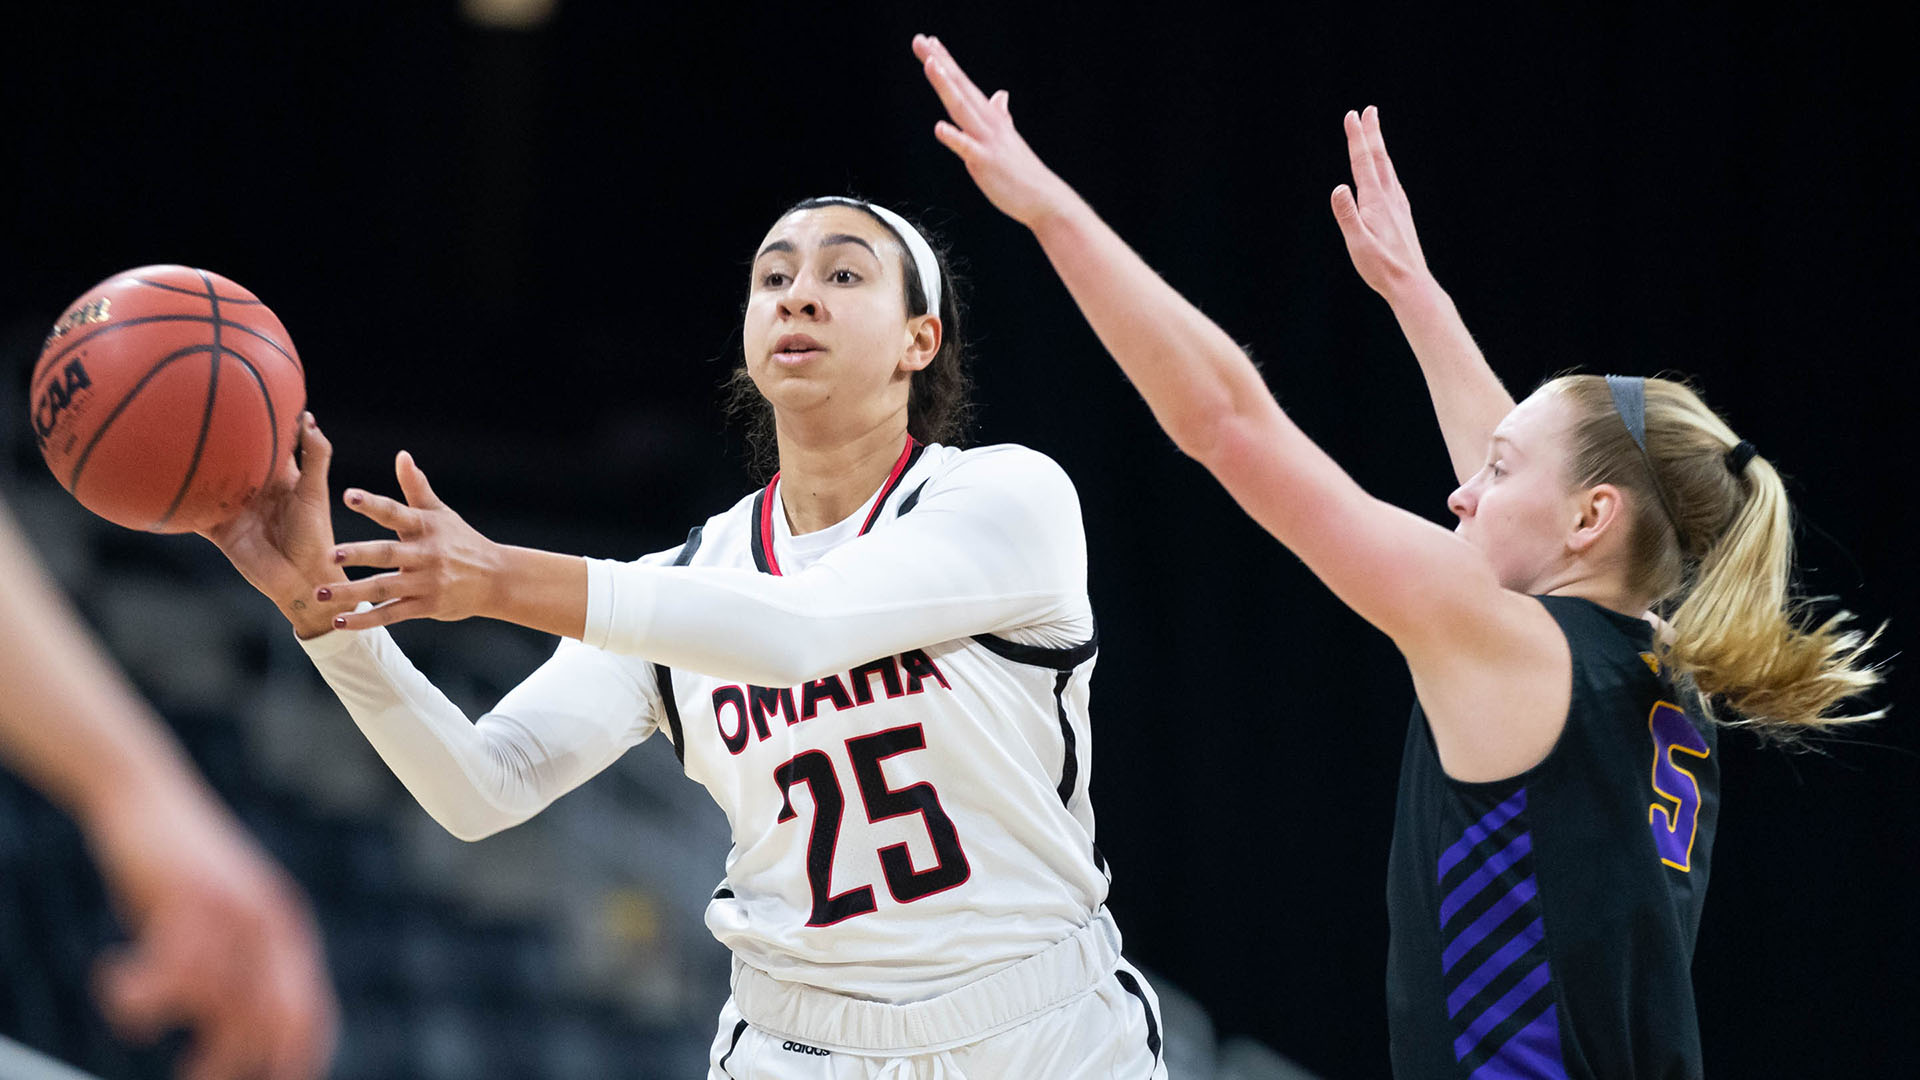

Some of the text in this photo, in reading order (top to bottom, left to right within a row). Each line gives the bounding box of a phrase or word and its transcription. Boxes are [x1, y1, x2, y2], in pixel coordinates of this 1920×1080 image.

[35, 357, 92, 450] CAA
[711, 648, 953, 756] OMAHA
[773, 722, 972, 928] 25
[1648, 700, 1710, 873] 5
[782, 1040, 831, 1057] adidas
